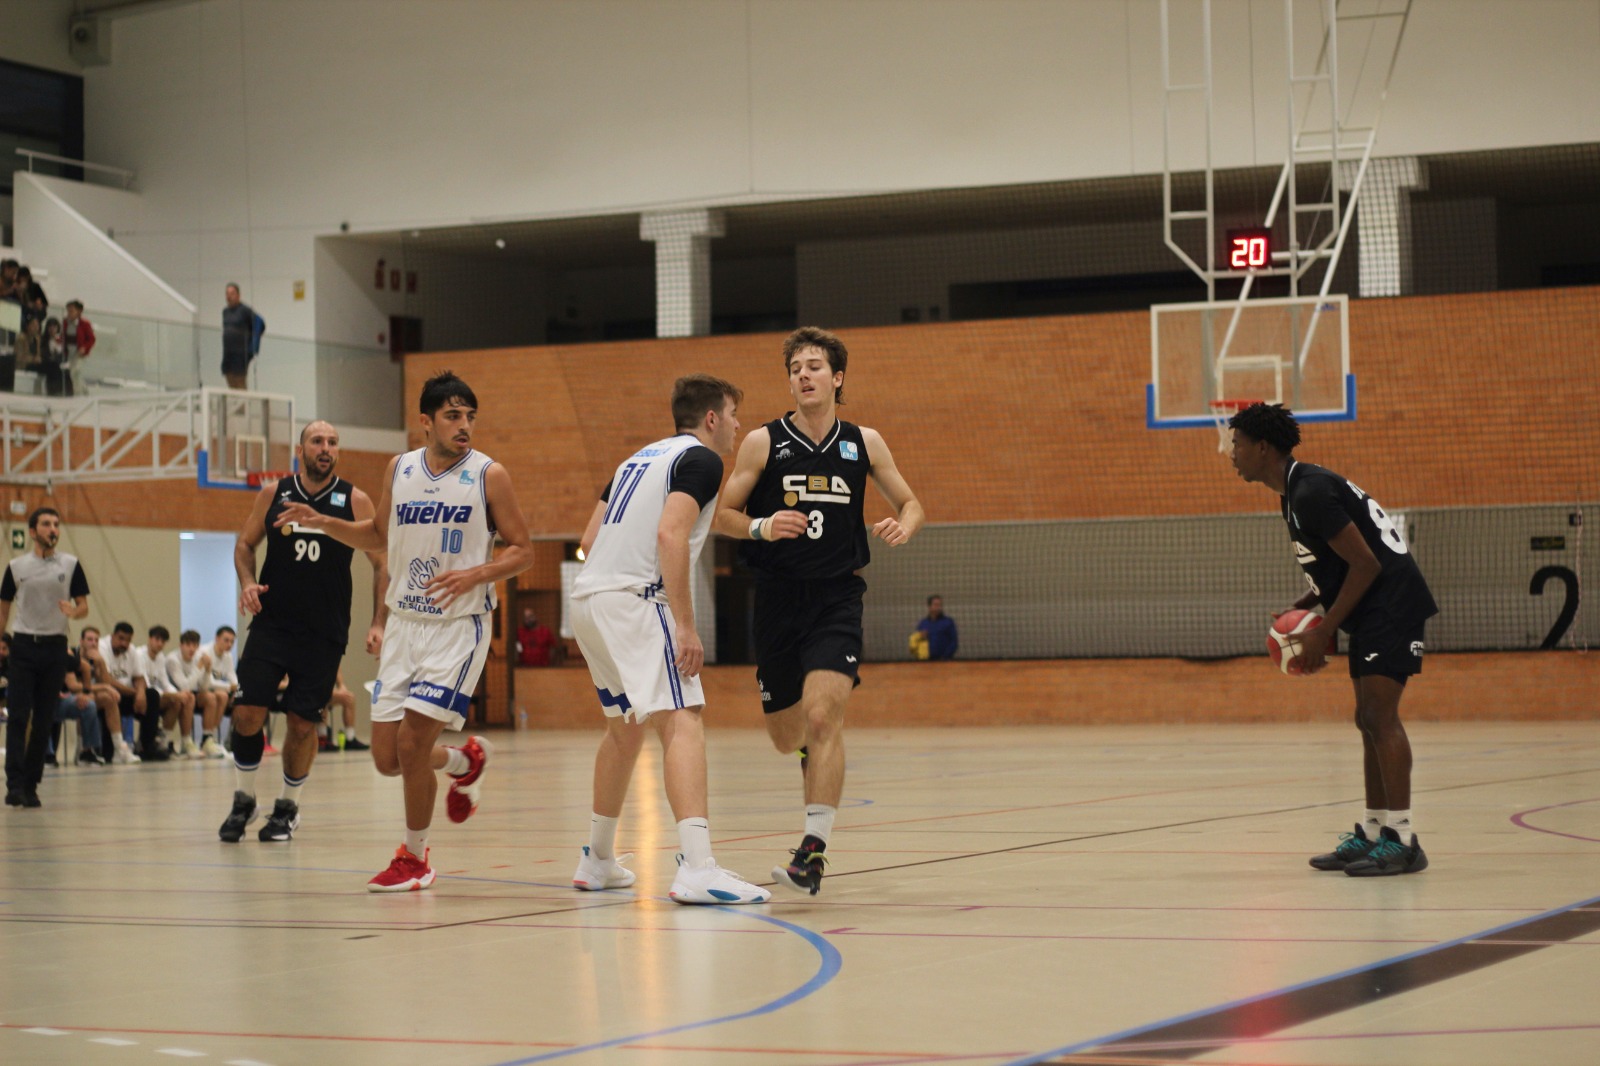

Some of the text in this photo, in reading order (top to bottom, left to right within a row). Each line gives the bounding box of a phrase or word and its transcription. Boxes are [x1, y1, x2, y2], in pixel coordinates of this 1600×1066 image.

[1231, 238, 1266, 267] 20
[602, 462, 651, 525] 11
[396, 502, 474, 526] Huelva
[807, 509, 824, 540] 3
[1367, 498, 1408, 555] 8
[295, 539, 321, 562] 90
[441, 527, 464, 554] 10
[1529, 565, 1579, 649] 2
